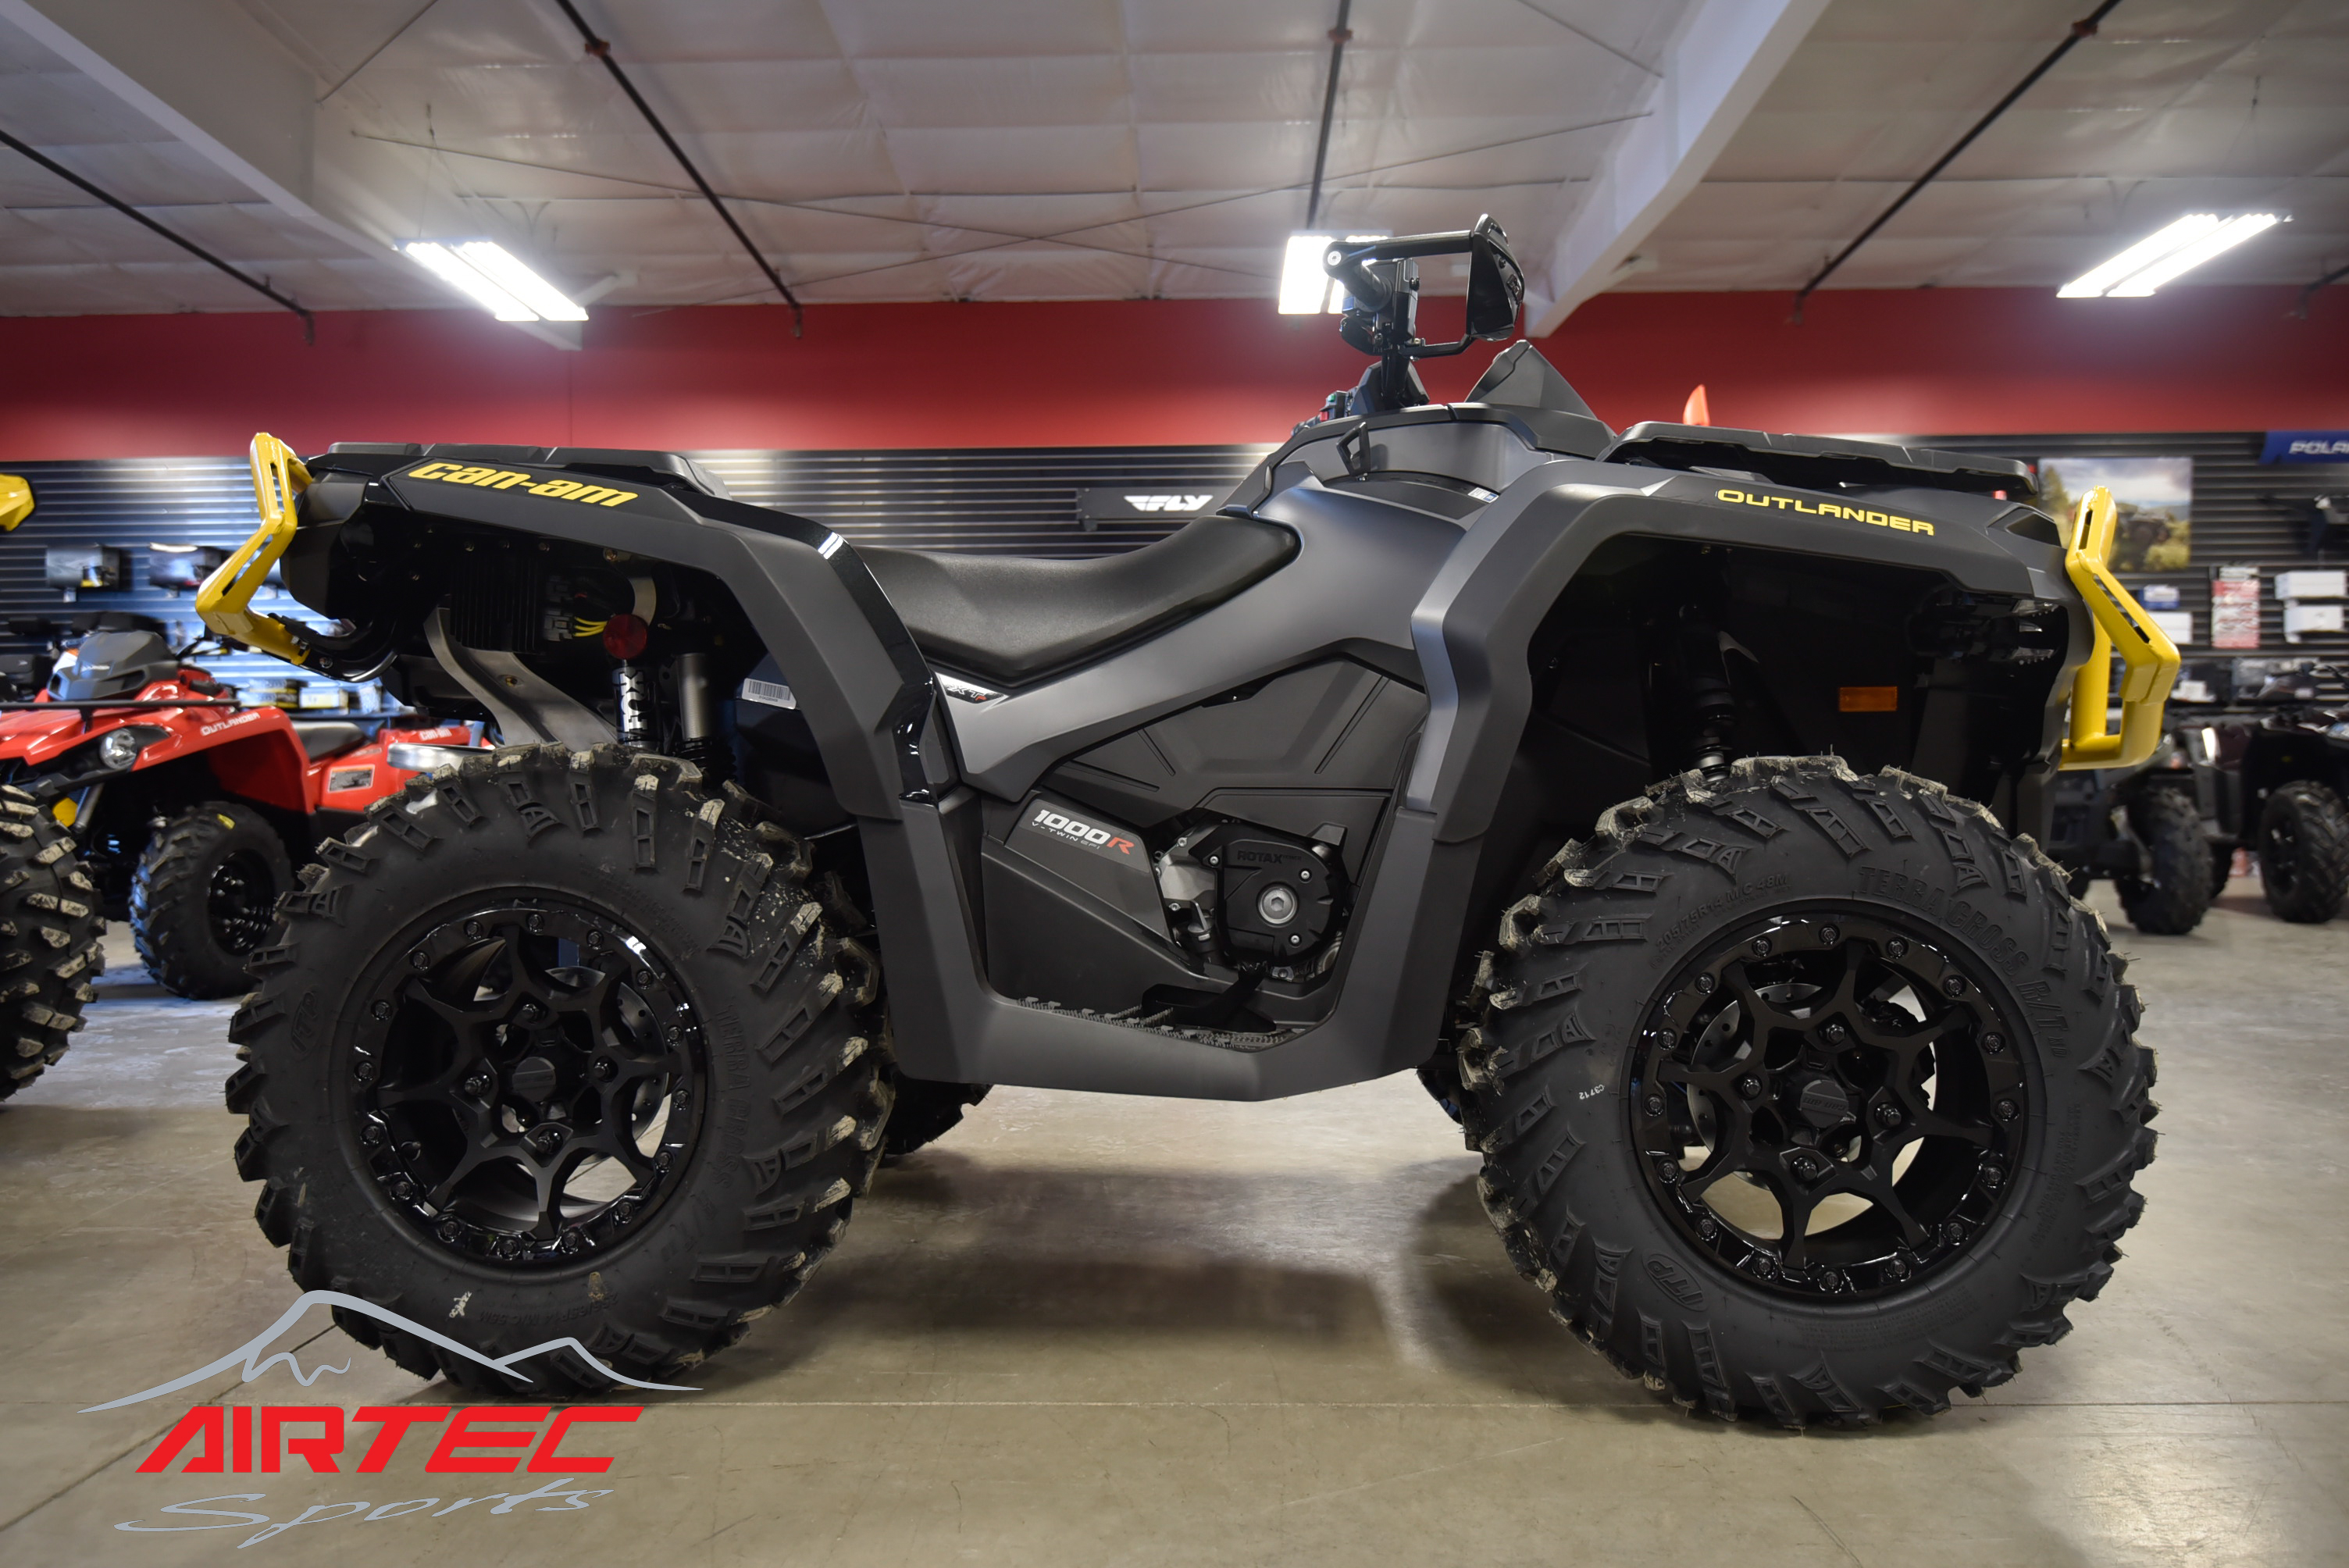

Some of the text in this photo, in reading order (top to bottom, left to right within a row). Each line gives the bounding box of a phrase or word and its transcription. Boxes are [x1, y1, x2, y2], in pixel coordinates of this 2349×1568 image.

[2289, 439, 2349, 454] POLA
[408, 462, 639, 508] can-am
[1125, 494, 1214, 512] FLY
[1717, 488, 1935, 536] OUTLANDER
[200, 711, 262, 736] OUTLANDER
[1034, 809, 1135, 855] 1000R
[1080, 839, 1101, 850] EFI
[1236, 850, 1282, 864] ROTAX
[1656, 896, 1723, 951] 205/75R14
[1859, 865, 1945, 914] TERRA
[1947, 900, 2030, 976] CROSS
[716, 1003, 750, 1092] TERRA
[1578, 1084, 1605, 1099] C3712
[714, 1098, 750, 1189] CROSS
[1646, 1258, 1705, 1306] ITP
